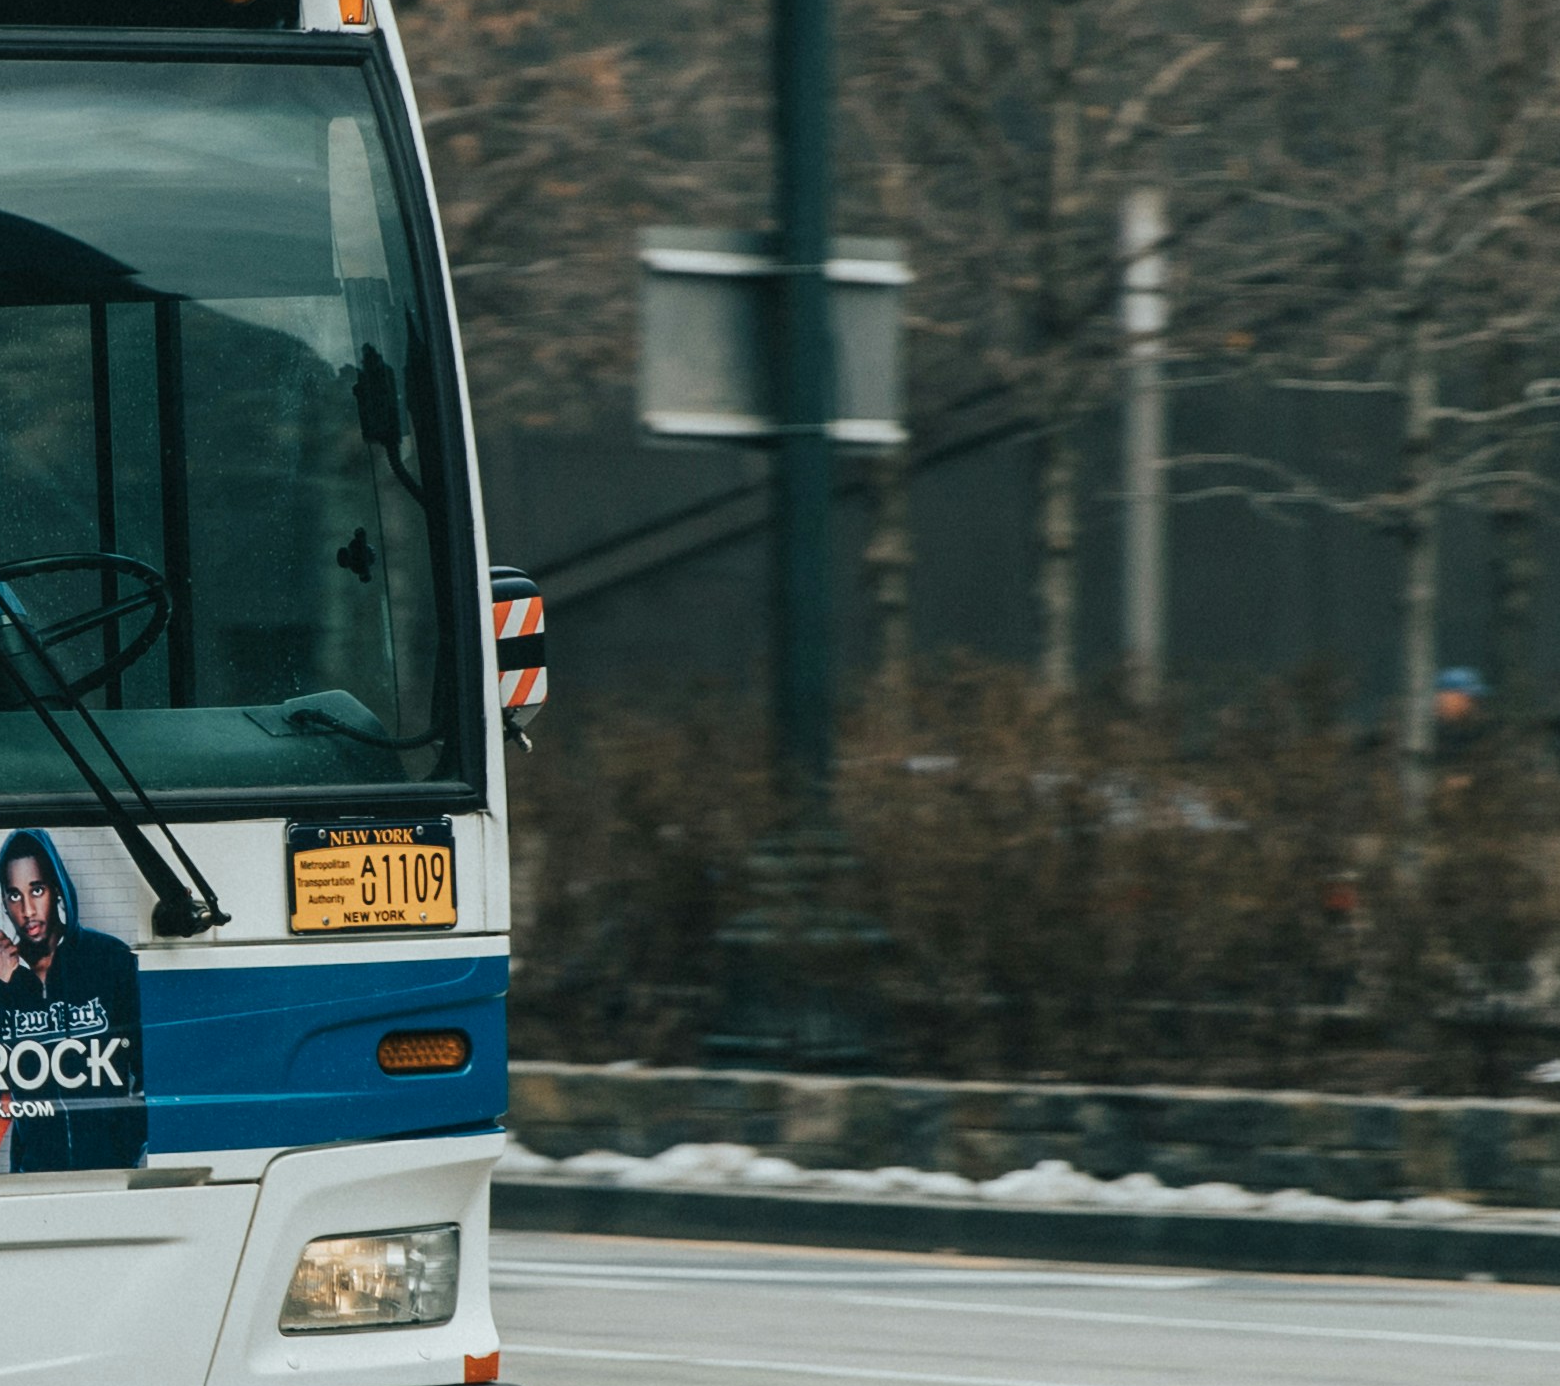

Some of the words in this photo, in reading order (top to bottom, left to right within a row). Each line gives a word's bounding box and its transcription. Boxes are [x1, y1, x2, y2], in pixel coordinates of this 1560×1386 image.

[329, 830, 371, 846] NEW
[373, 827, 415, 845] YORK
[300, 859, 351, 872] Metropolitan
[297, 876, 356, 889] Transportation
[308, 893, 346, 906] Authority
[343, 911, 371, 924] NEW
[374, 909, 407, 923] YORK
